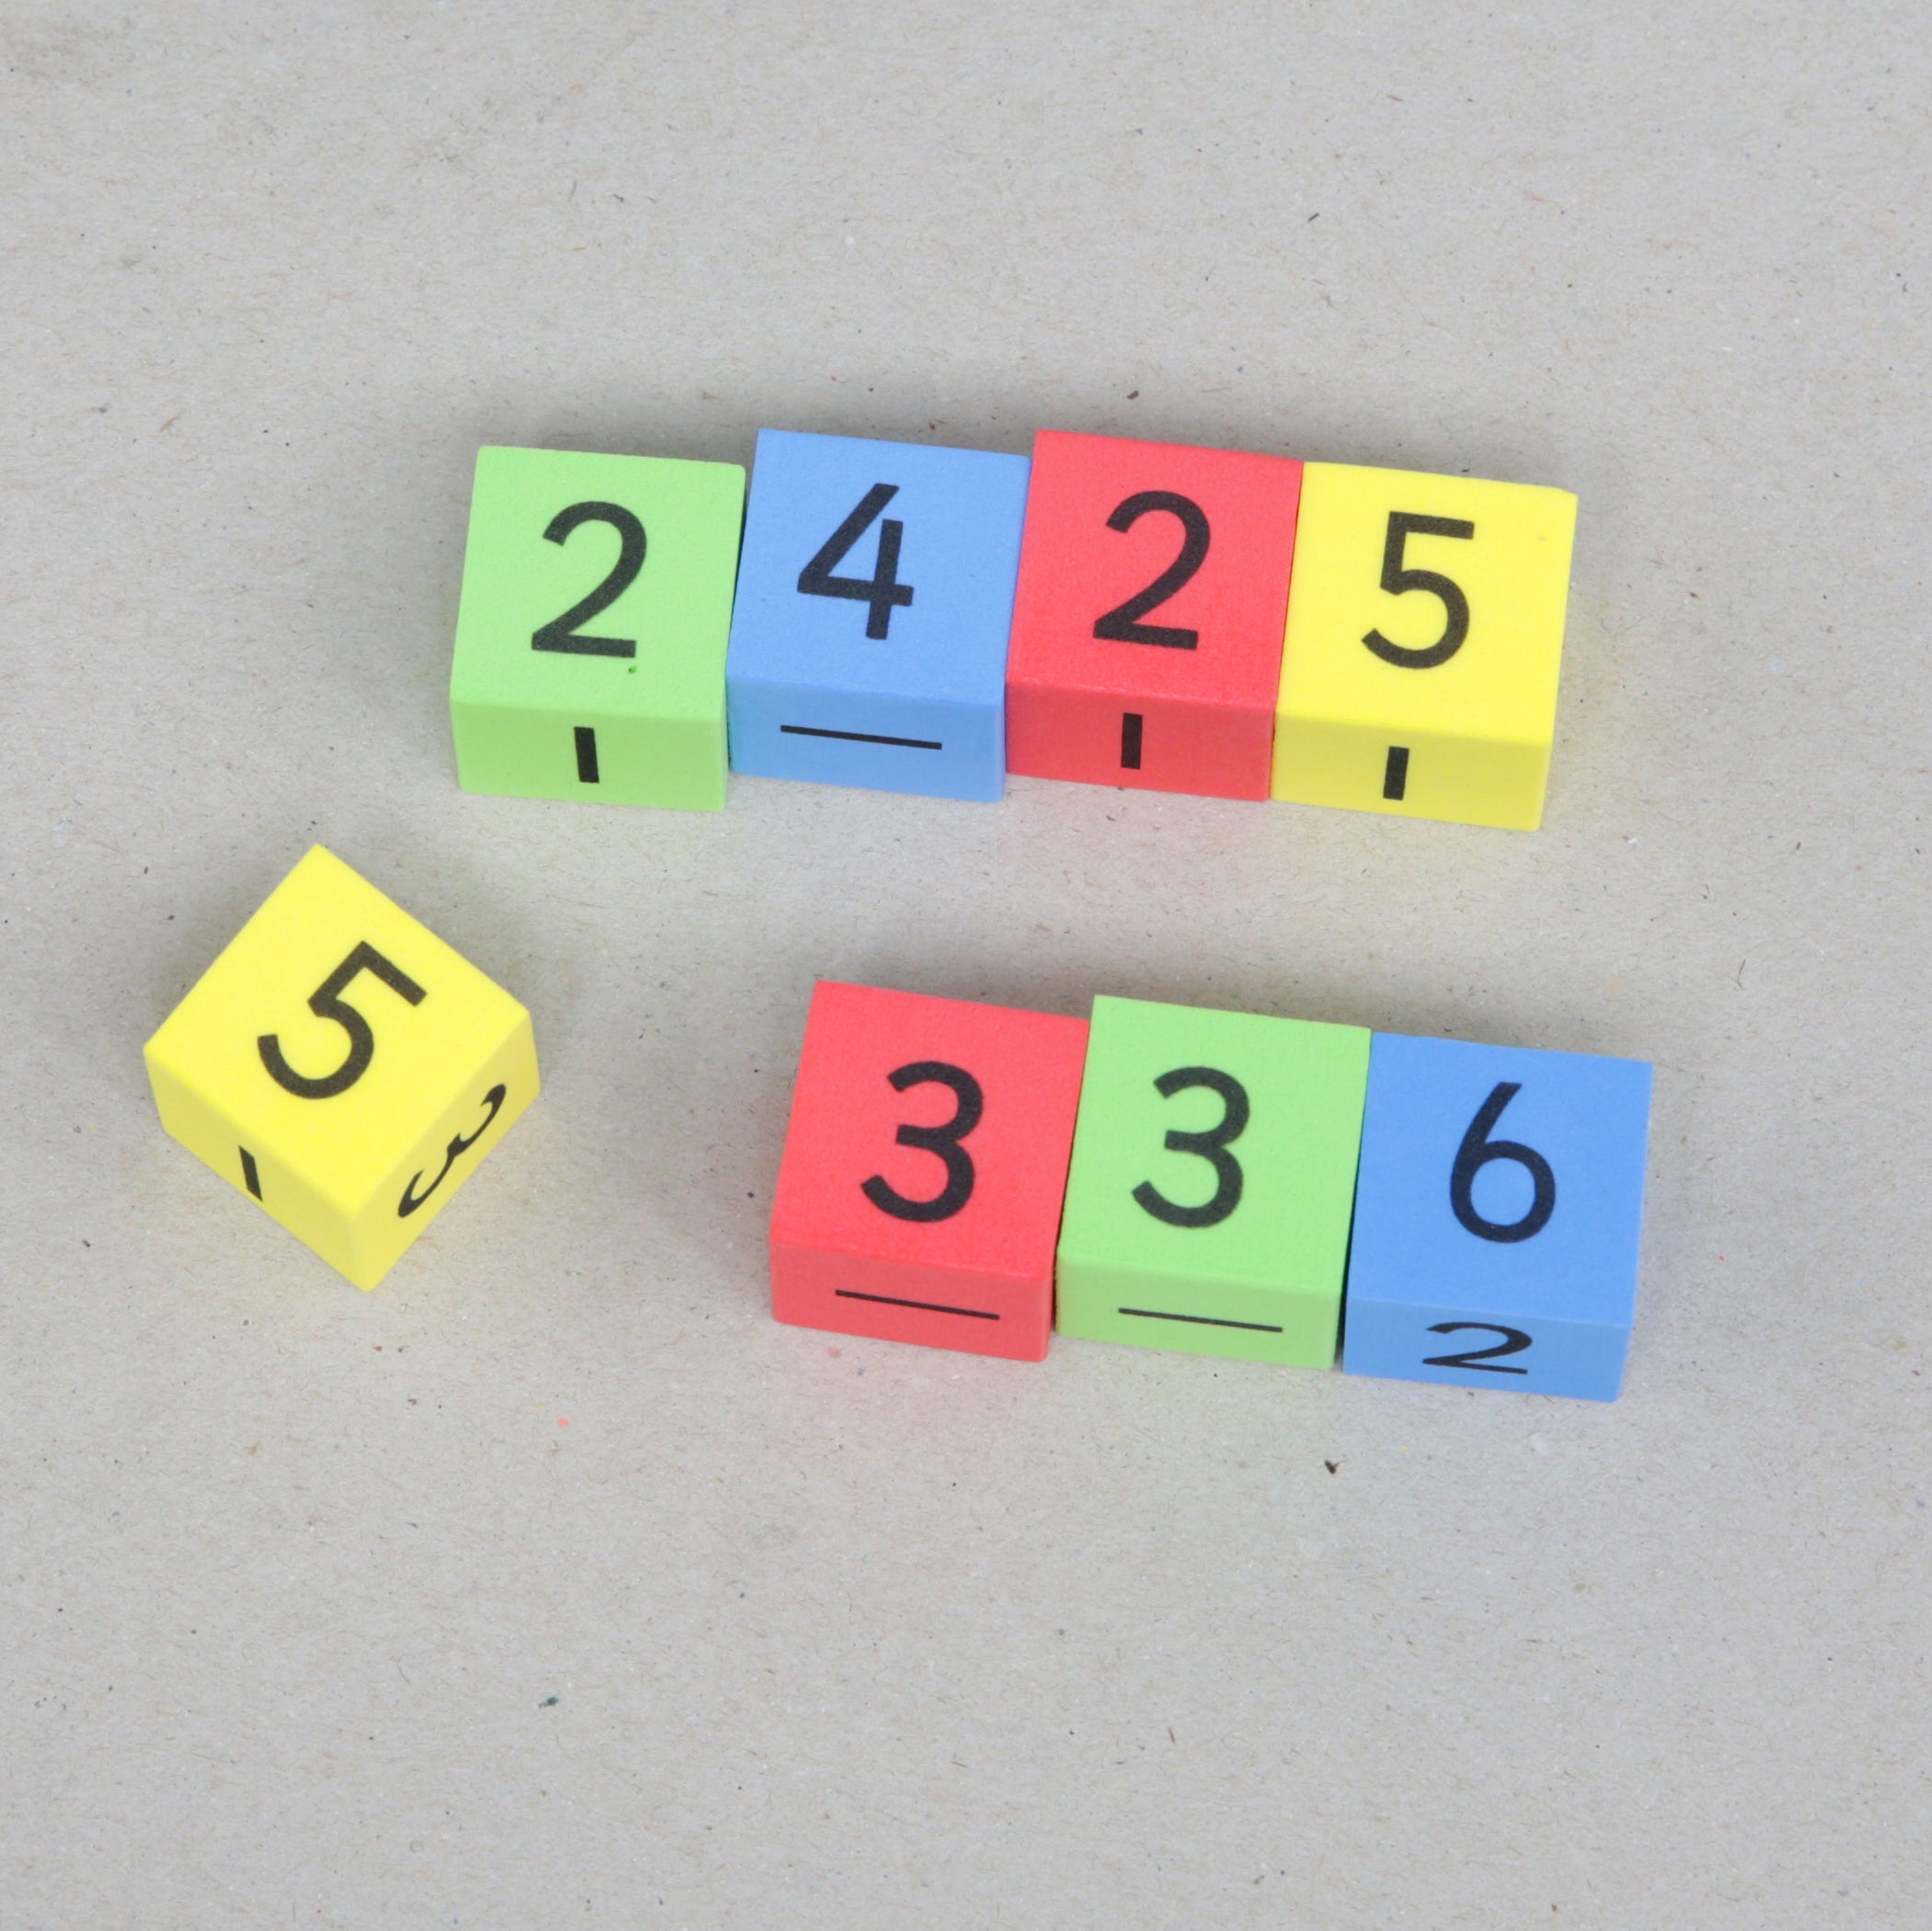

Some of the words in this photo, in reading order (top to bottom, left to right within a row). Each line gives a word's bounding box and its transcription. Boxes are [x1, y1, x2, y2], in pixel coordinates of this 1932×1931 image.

[532, 501, 646, 658] 2
[798, 484, 913, 639] 4
[1094, 491, 1210, 649] 2
[1362, 511, 1474, 669] 5
[574, 727, 599, 783] 1
[1121, 713, 1143, 769] 1
[1384, 746, 1409, 800] 1
[259, 941, 426, 1098] 5
[239, 1146, 262, 1201] 1
[398, 1084, 506, 1217] 3
[862, 1062, 983, 1222] 3
[1133, 1067, 1249, 1228] 3
[1451, 1083, 1555, 1243] 6
[1423, 1323, 1532, 1374] 2
